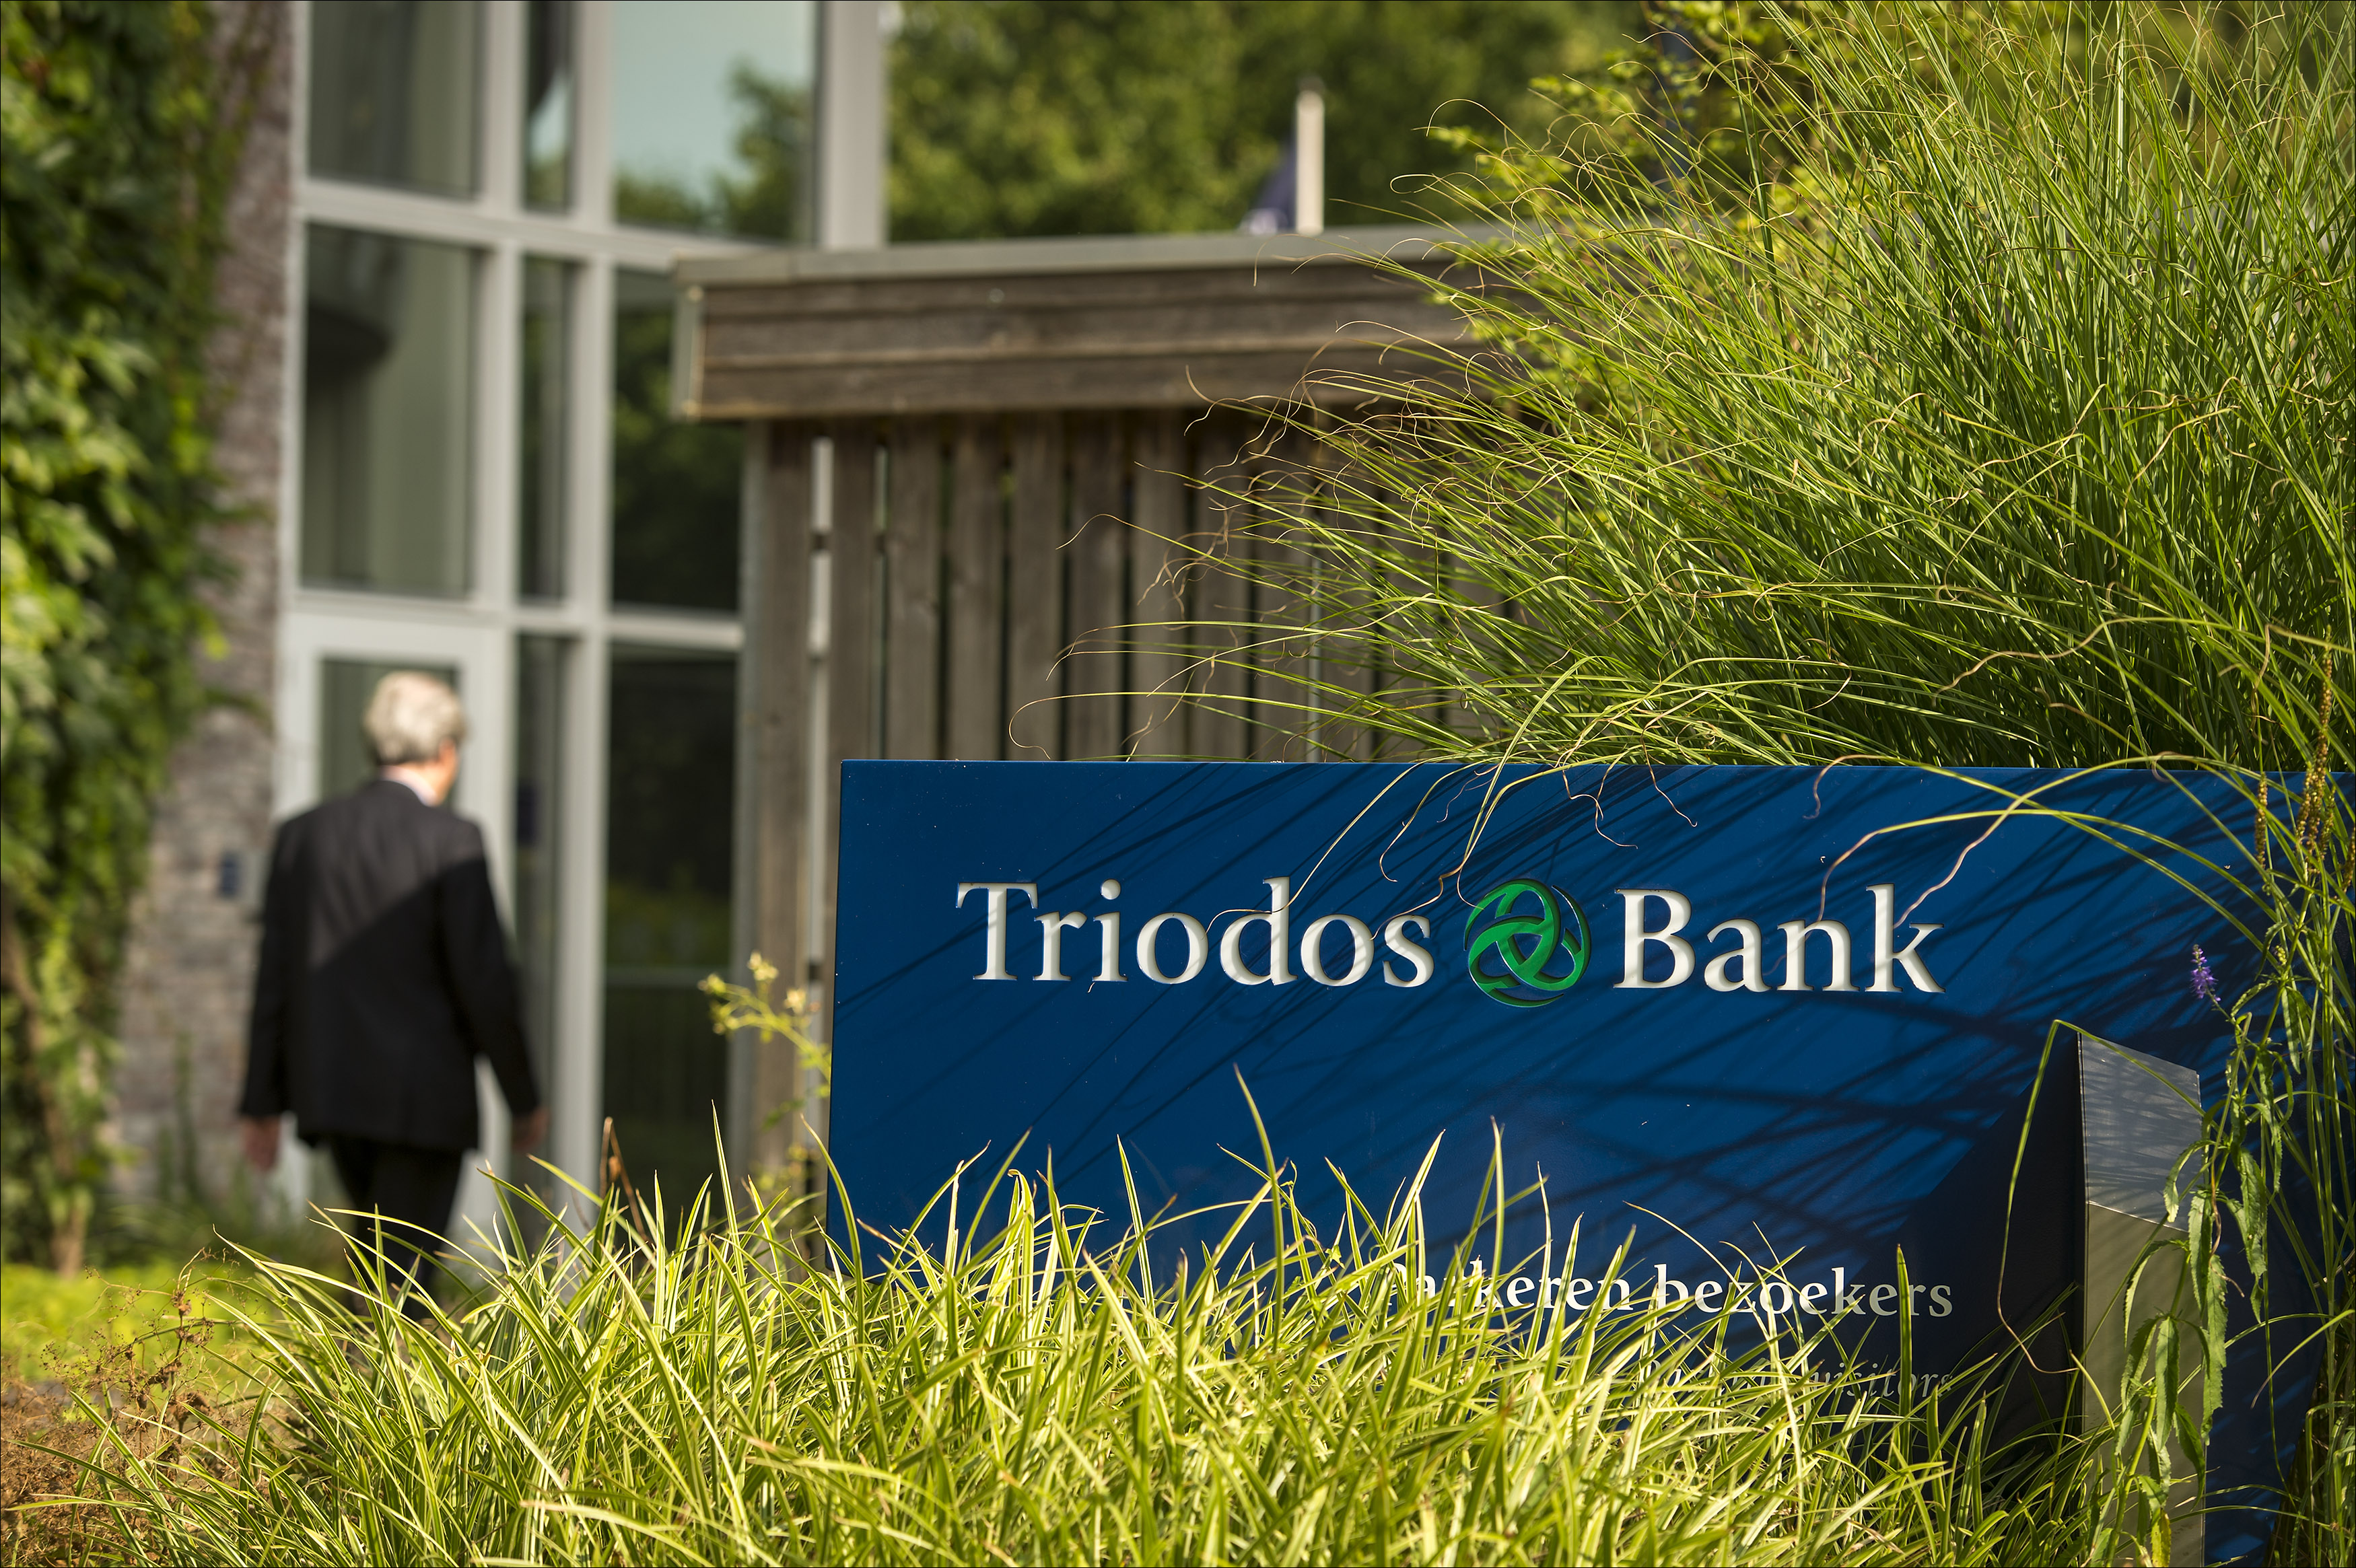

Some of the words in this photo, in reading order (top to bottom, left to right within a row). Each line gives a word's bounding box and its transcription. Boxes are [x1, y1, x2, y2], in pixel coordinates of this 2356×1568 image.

[955, 876, 1434, 987] Triodos
[1614, 883, 1945, 993] Bank
[1653, 1263, 1953, 1318] bezoekers
